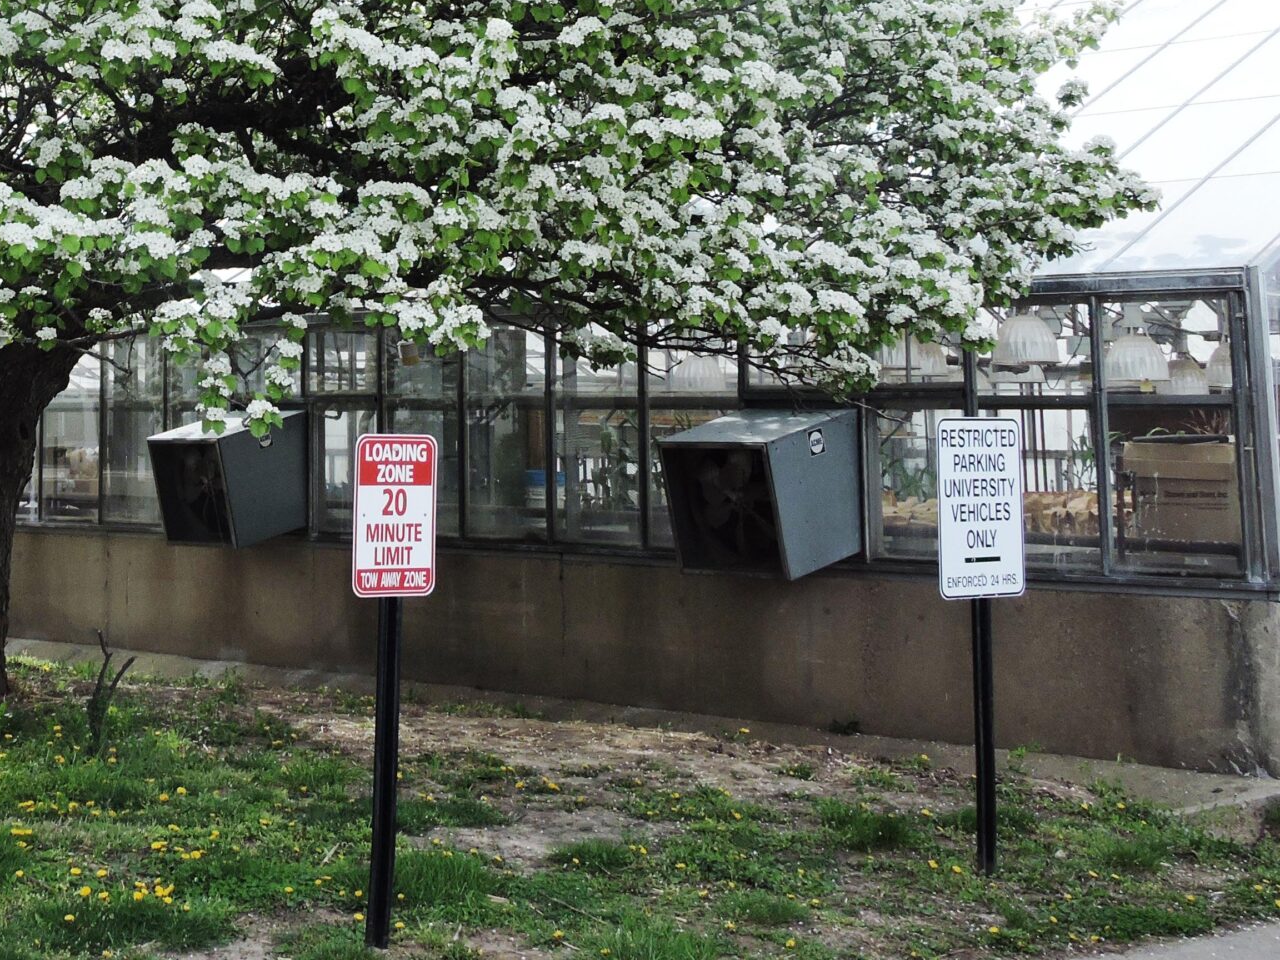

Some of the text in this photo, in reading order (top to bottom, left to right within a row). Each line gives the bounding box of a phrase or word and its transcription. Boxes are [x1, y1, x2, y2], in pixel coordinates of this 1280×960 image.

[941, 428, 1016, 448] RESTRICTED
[365, 443, 427, 462] LOADING
[953, 453, 1005, 473] PARKING
[376, 464, 414, 483] ZONE
[944, 477, 1015, 498] UNIVERSITY
[382, 488, 407, 516] 20
[951, 502, 1011, 522] VEHICLES
[366, 523, 422, 543] MINUTE
[966, 529, 997, 549] ONLY
[374, 546, 413, 566] LIMIT
[360, 571, 427, 589] TOW AWAY ZONE
[947, 574, 1019, 589] ENFORCED 24 HRS.
